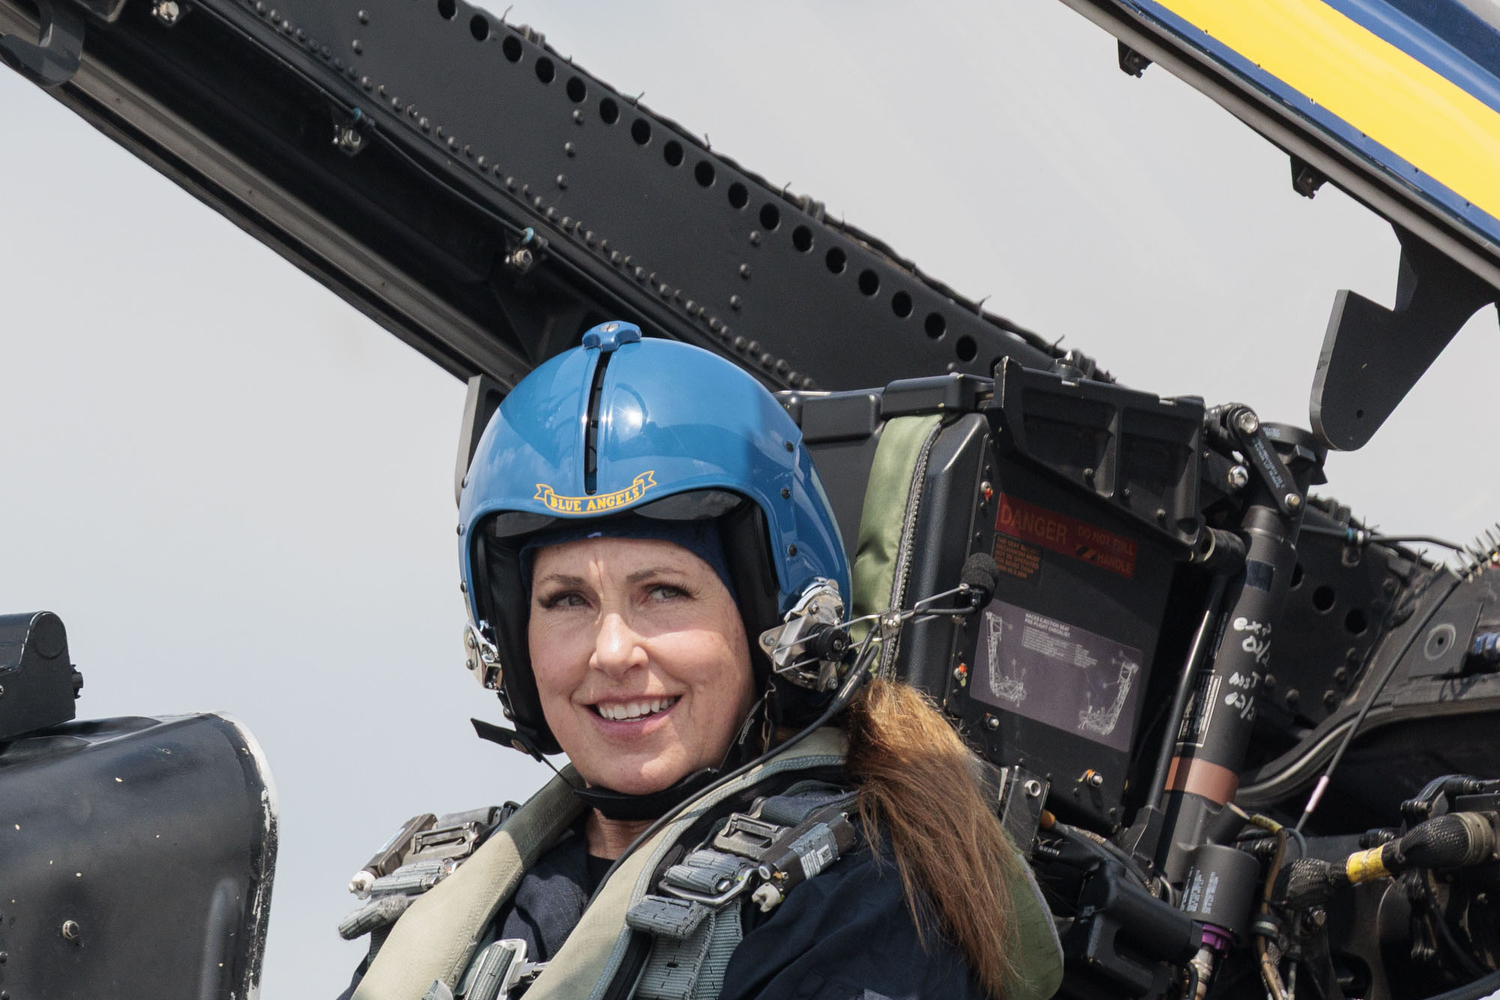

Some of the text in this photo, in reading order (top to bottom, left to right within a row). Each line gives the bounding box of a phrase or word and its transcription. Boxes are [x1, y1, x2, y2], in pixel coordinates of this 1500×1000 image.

[550, 487, 640, 511] BLUE ANGELS
[1000, 504, 1067, 545] DANGER
[1077, 526, 1091, 539] DO
